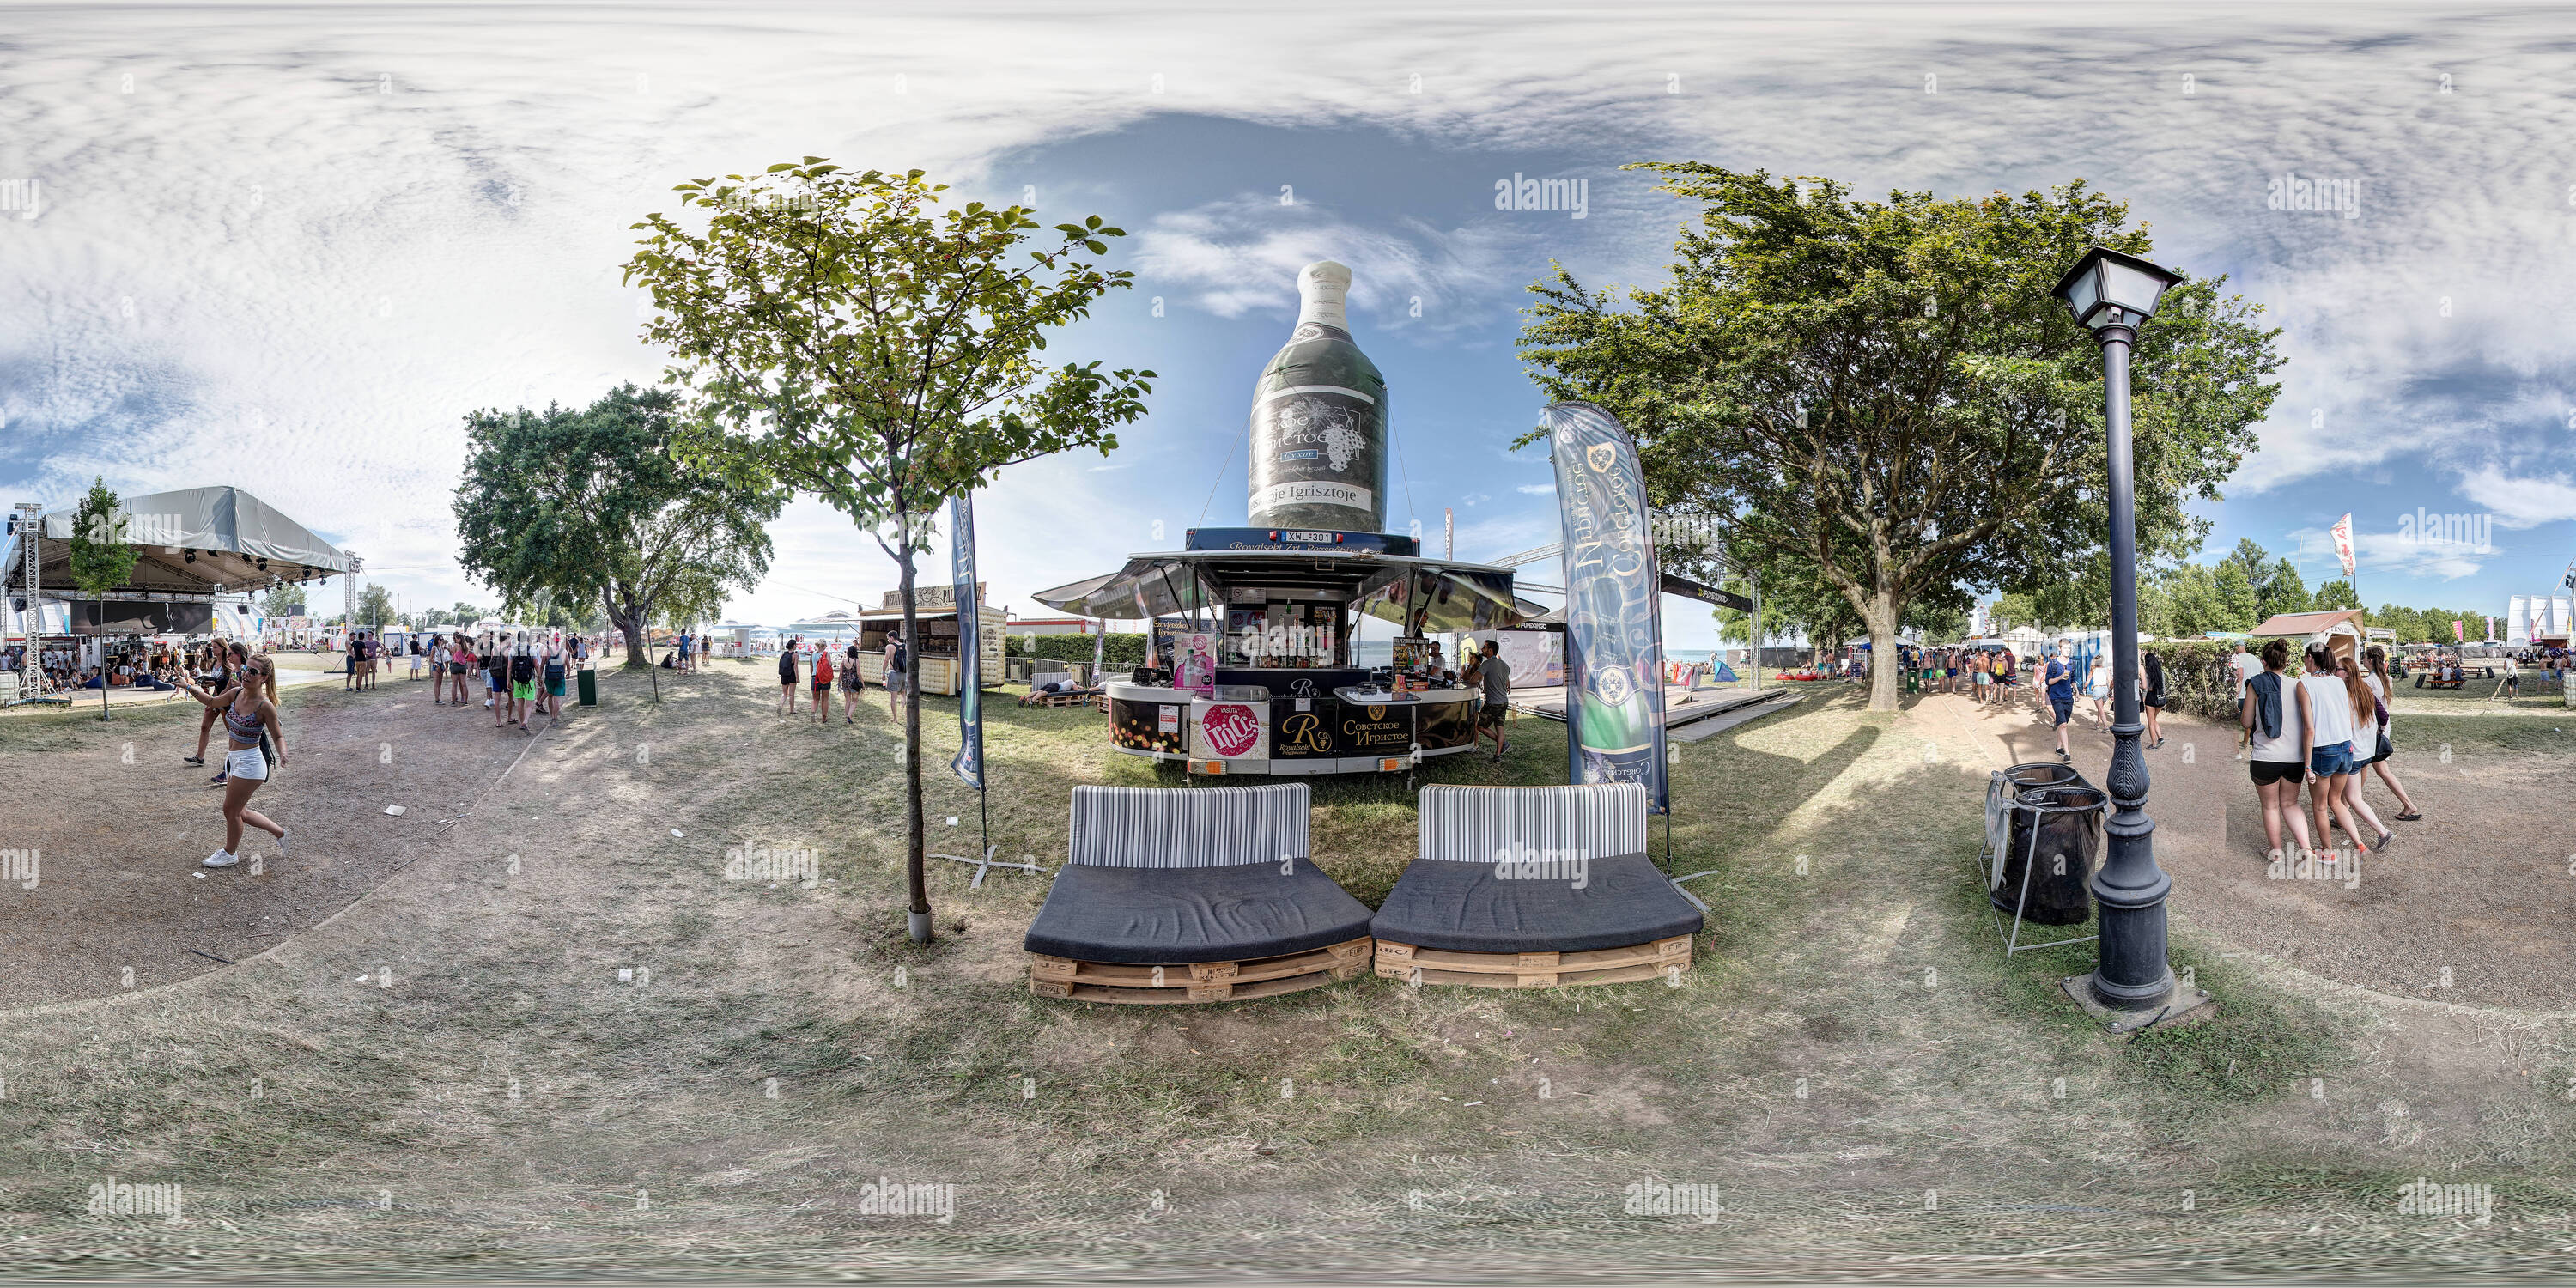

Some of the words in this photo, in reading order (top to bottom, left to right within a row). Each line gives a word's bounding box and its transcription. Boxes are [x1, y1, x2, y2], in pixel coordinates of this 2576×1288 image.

[1291, 485, 1357, 501] Igrisztoje
[1288, 532, 1329, 542] XWL-301
[1343, 720, 1400, 735] Советское
[1355, 731, 1409, 746] Игристое
